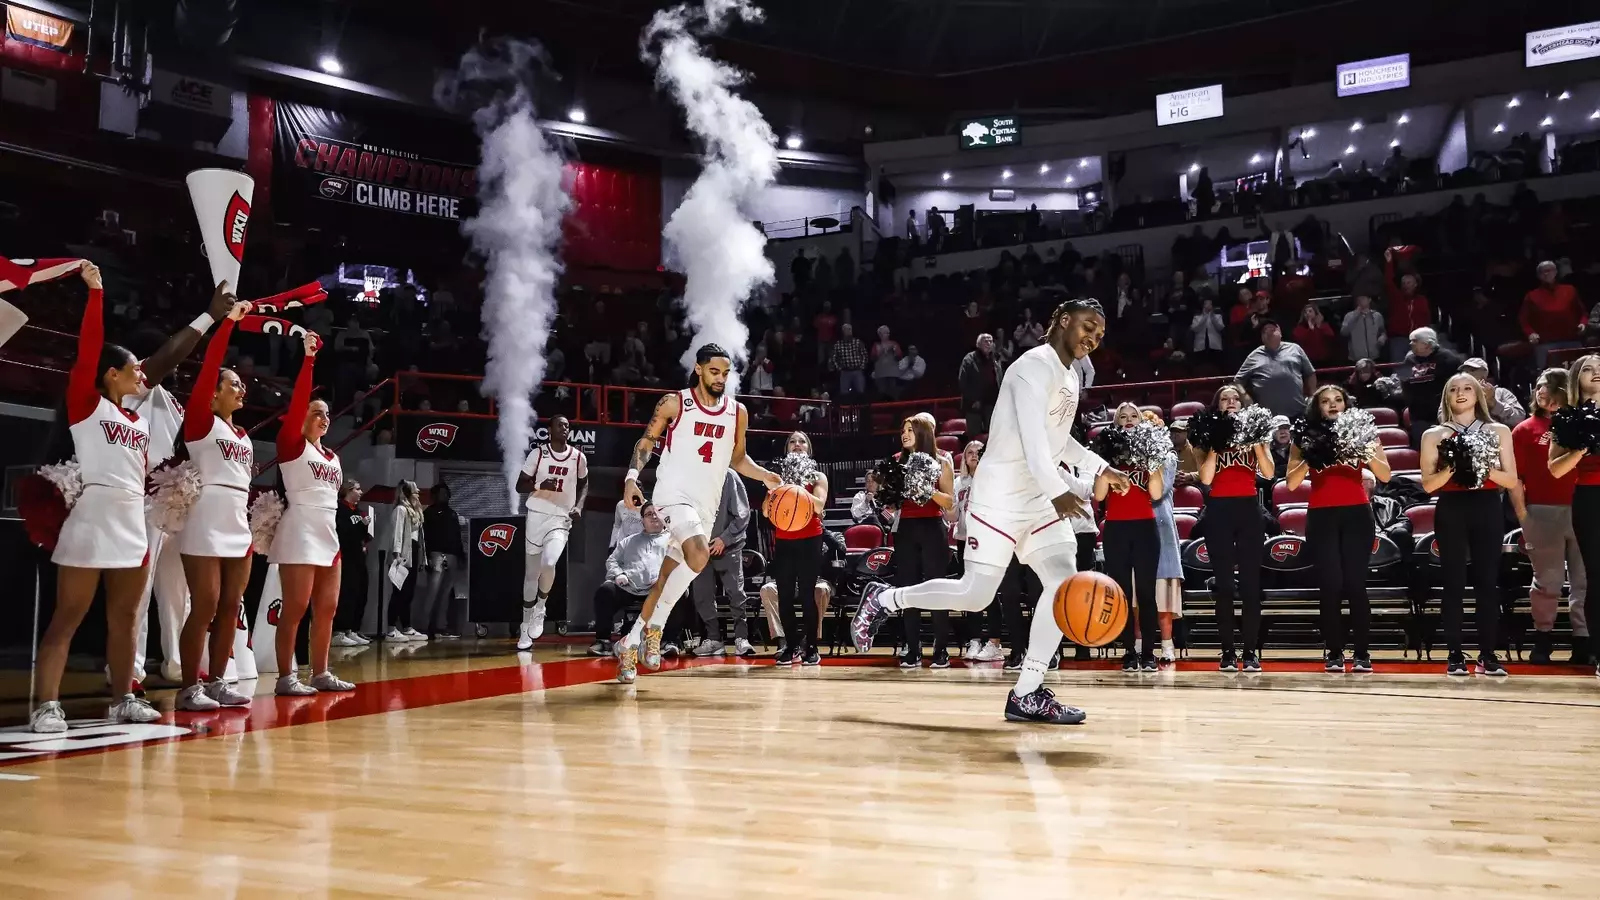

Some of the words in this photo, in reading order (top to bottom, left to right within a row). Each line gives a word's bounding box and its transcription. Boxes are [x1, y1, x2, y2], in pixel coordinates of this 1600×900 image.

[22, 19, 59, 36] UTEP
[1358, 65, 1404, 76] HOUCHENS
[1358, 72, 1404, 84] INDUSTRIES
[171, 79, 213, 98] ACE
[1169, 90, 1209, 101] American
[363, 143, 379, 152] WKU
[381, 147, 420, 160] ATHLETICS
[294, 138, 477, 198] CHAMPIONS
[327, 180, 343, 189] WKU
[356, 183, 411, 211] CLIMB
[415, 193, 460, 219] HERE
[231, 209, 249, 243] WKU
[428, 428, 448, 438] WKU
[693, 421, 726, 439] WKU
[697, 441, 714, 463] 4
[548, 465, 569, 477] WKU
[489, 529, 507, 540] WKU
[1278, 543, 1295, 551] WKU
[1099, 585, 1115, 625] ELITE
